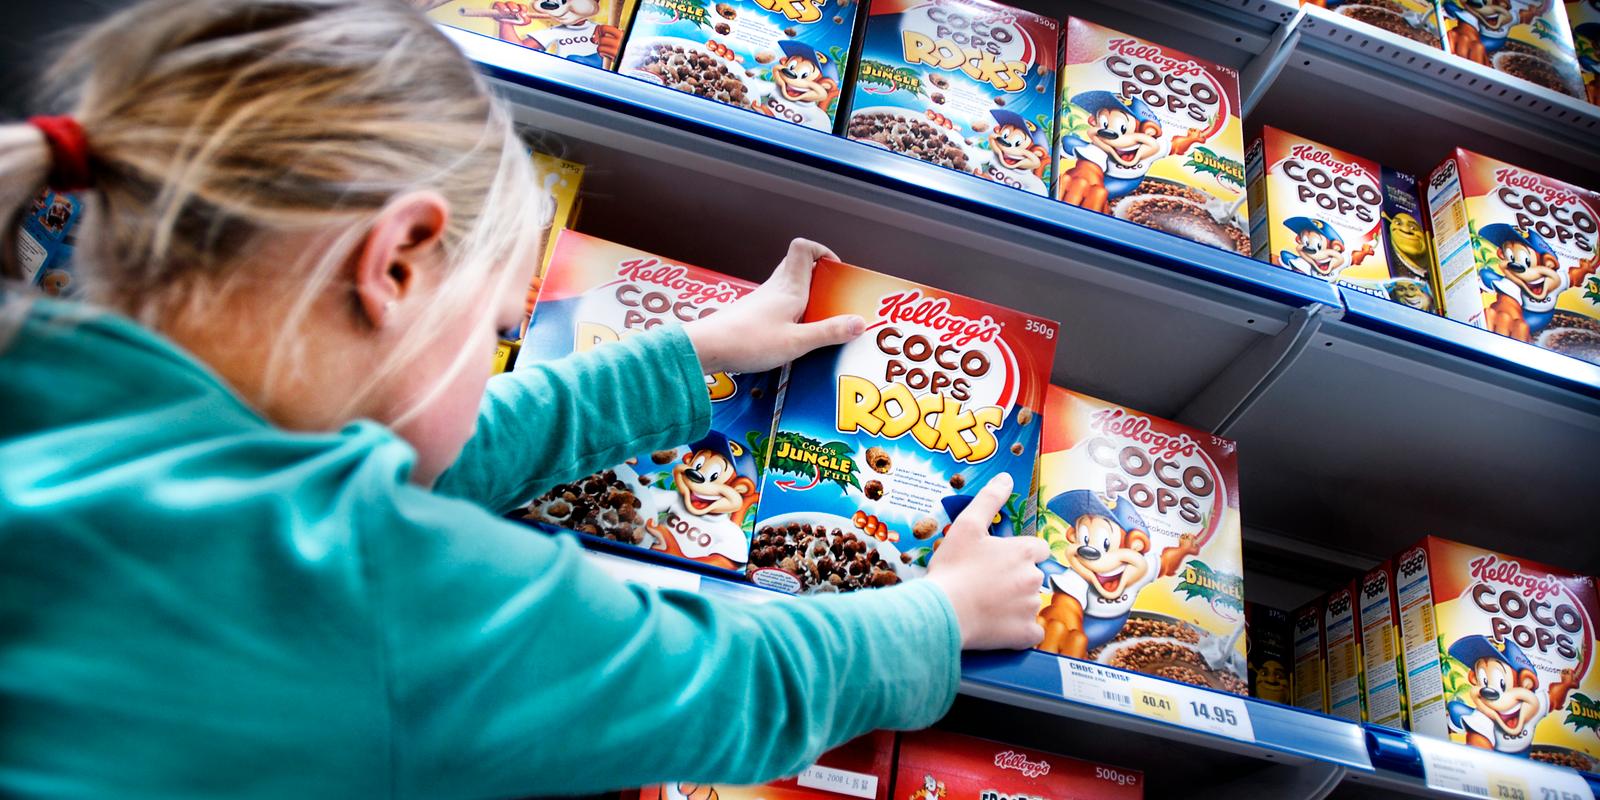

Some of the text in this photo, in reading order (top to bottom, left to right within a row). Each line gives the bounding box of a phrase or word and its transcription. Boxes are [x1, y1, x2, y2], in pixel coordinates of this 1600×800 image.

[558, 36, 589, 46] COCO
[927, 7, 1012, 43] COCO
[937, 25, 1001, 55] POPS
[1034, 18, 1056, 30] 350g
[862, 64, 919, 87] JUNGLE
[903, 30, 1027, 92] ROCKS
[1108, 38, 1201, 77] Kellogg's
[1216, 64, 1237, 79] 375g
[1104, 55, 1218, 105] COCO
[767, 98, 804, 124] COCO
[1122, 81, 1207, 122] POPS
[988, 166, 1022, 189] COCO
[1193, 150, 1244, 179] DJUNGEL
[1292, 145, 1362, 177] Kellogg's
[1283, 160, 1382, 206] COCO
[1496, 168, 1577, 206] Kellogg's
[1297, 185, 1373, 223] POPS
[1498, 187, 1597, 234] COCO
[1515, 212, 1592, 252] POPS
[617, 258, 736, 304] Kellogg's
[878, 291, 996, 347] Kellogg's
[1025, 319, 1055, 340] 350g
[876, 326, 991, 378] COCO
[885, 359, 971, 402] POPS
[838, 374, 1004, 463] ROCKS
[1092, 408, 1196, 460] Kellogg's
[777, 442, 851, 474] JUNGLE
[1211, 435, 1235, 454] 375g
[823, 469, 851, 482] Fun
[1088, 436, 1215, 498] COCO
[1105, 472, 1202, 524] POPS
[667, 512, 712, 548] COCO
[1400, 554, 1424, 573] COCO
[1470, 555, 1561, 600] Kellogg's
[1472, 583, 1583, 633] COCO
[1491, 615, 1578, 659] POPS
[1070, 662, 1094, 674] CHOC
[1142, 694, 1171, 711] 40.41
[1189, 701, 1239, 726] 14.95
[994, 751, 1050, 778] Kellogg's
